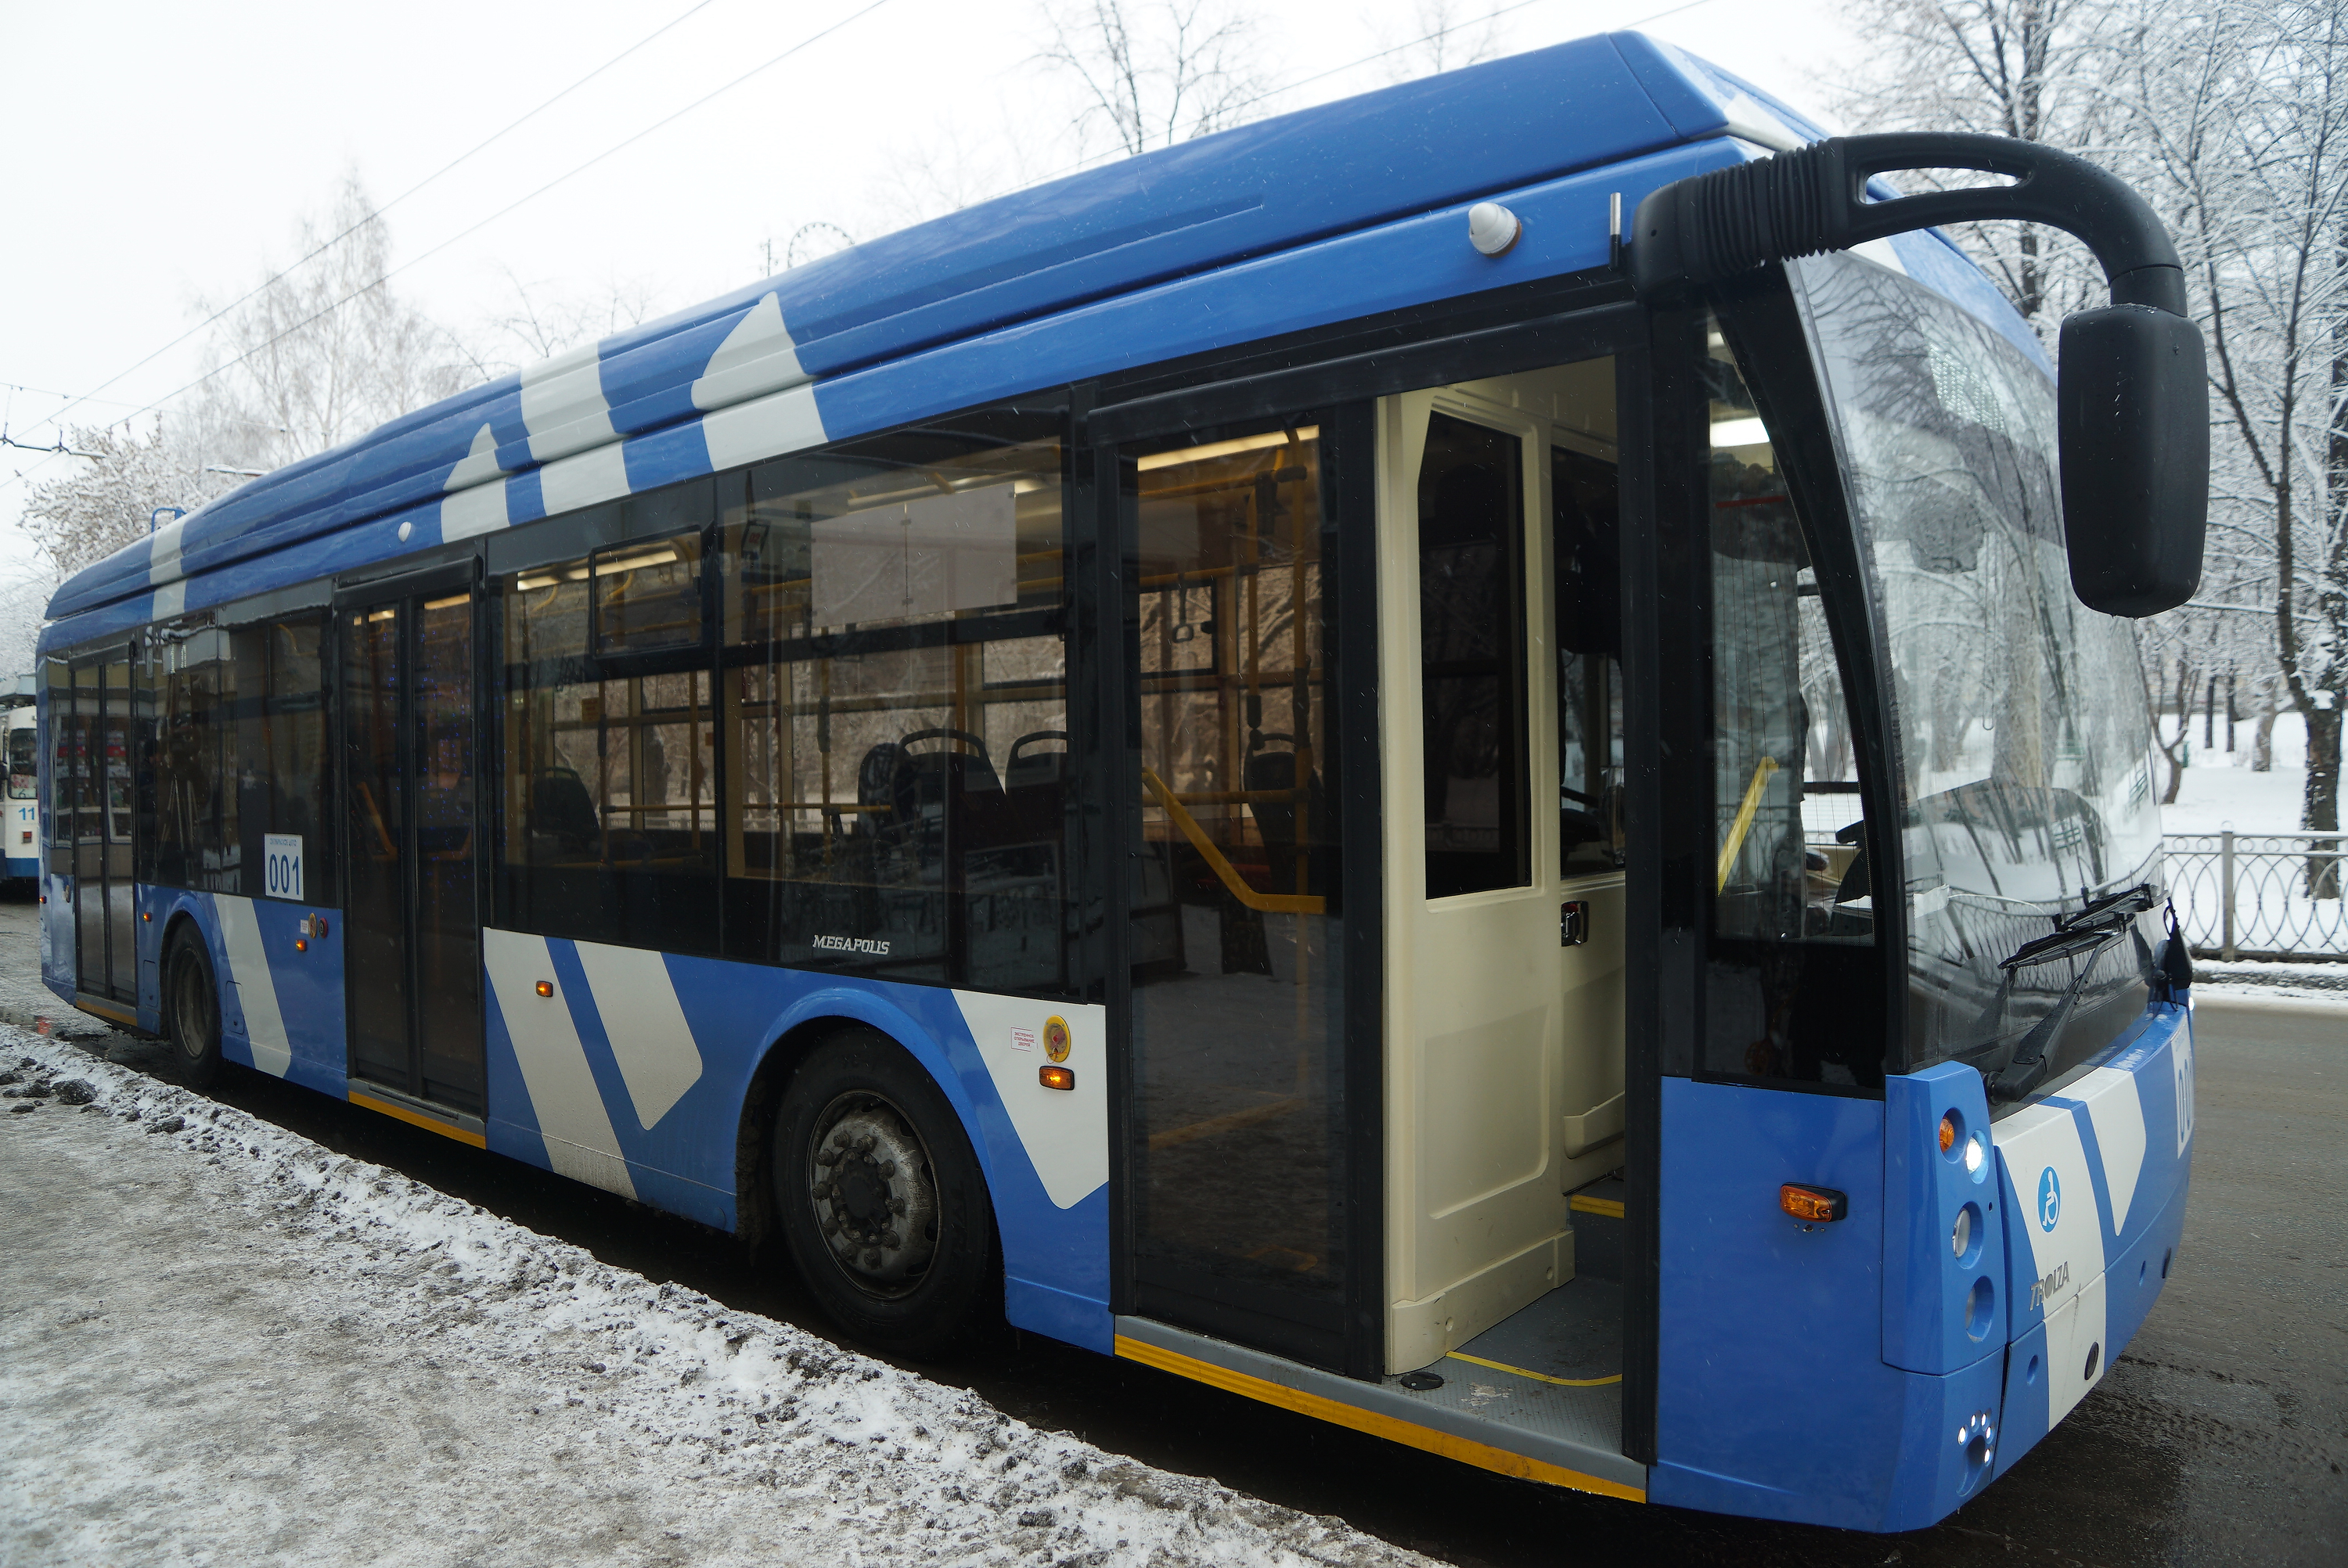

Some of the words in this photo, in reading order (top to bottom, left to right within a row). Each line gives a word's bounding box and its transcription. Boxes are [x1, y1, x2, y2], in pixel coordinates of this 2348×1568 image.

[268, 853, 300, 895] 001
[812, 934, 891, 955] MEGAPOLIS
[2029, 1261, 2070, 1311] TROLZA
